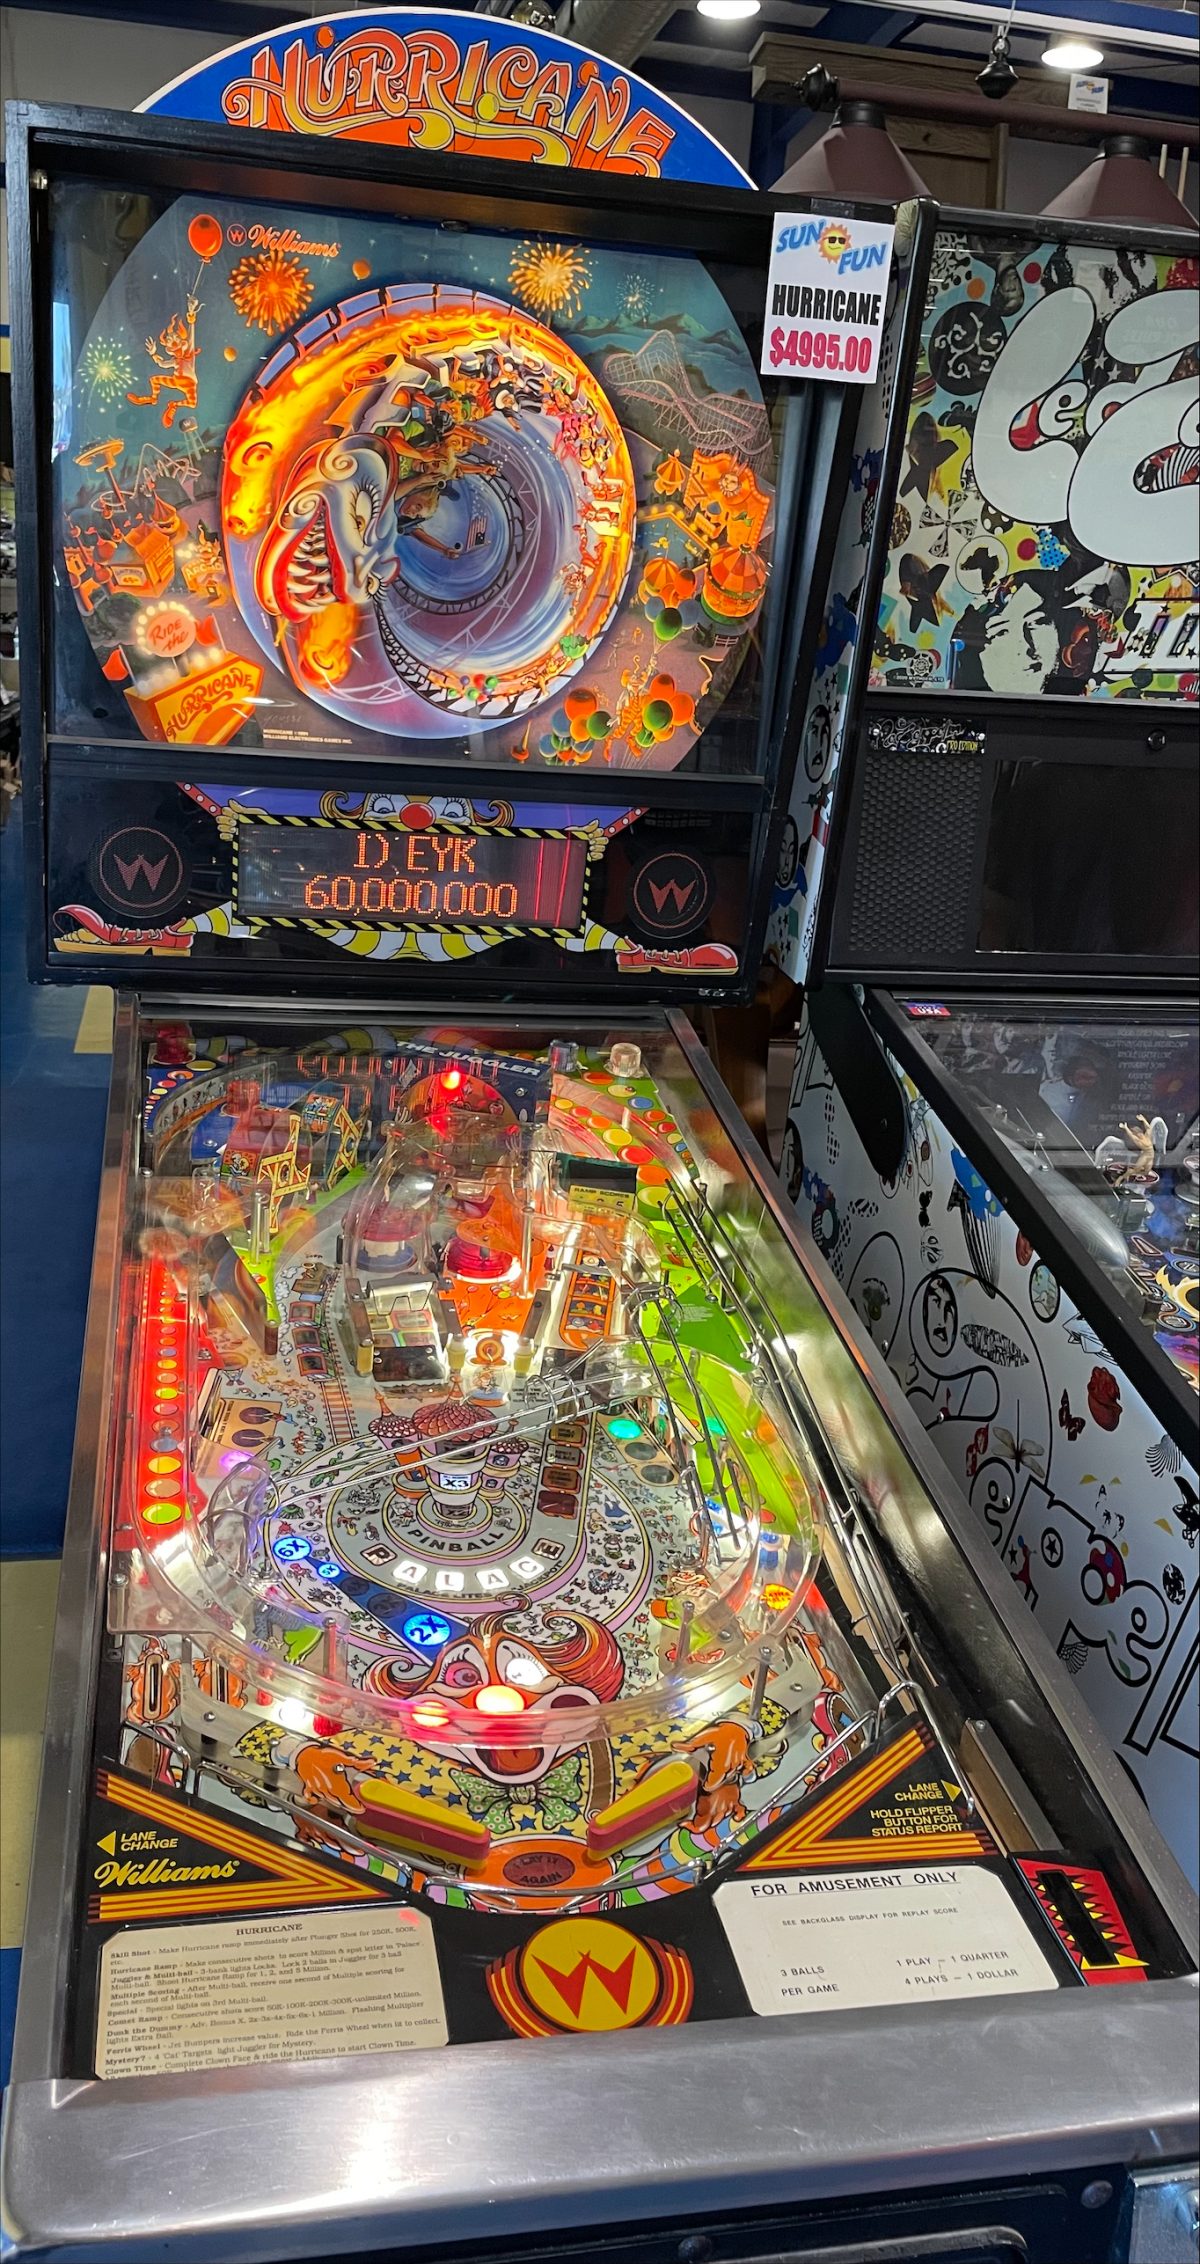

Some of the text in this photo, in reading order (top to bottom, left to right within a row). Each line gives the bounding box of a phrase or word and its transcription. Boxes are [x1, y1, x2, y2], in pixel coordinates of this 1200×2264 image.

[222, 28, 677, 178] HURRICANE
[247, 223, 340, 257] Williams
[776, 219, 827, 253] SUN
[837, 242, 889, 275] FUN
[772, 284, 881, 326] HURRICANE
[770, 326, 872, 374] $4995.00
[151, 618, 183, 643] RIDE
[162, 630, 190, 652] the
[166, 667, 256, 742] HURRICANE
[407, 835, 477, 873] EYK
[304, 874, 518, 920] 60,000,000
[397, 1041, 541, 1076] THE JUGGLER
[278, 1539, 307, 1557] 6X
[407, 1529, 504, 1552] PINBALL
[409, 1615, 447, 1642] 2X
[894, 1791, 944, 1801] CHANGE
[909, 1783, 940, 1792] LANE
[870, 1805, 953, 1819] HOLD FLIPPER
[884, 1814, 958, 1827] BUTTON FOR
[121, 1831, 157, 1843] LANE
[872, 1823, 962, 1837] STATUS REPORT
[120, 1838, 178, 1852] CHANGE
[94, 1858, 238, 1888] Williams
[750, 1872, 959, 1897] FOR AMUSEMENT ONLY
[800, 1915, 845, 1925] BACKGLASS
[849, 1913, 879, 1922] DISPLAY
[882, 1911, 898, 1919] FOR
[901, 1909, 929, 1918] REPLAY
[933, 1907, 959, 1915] SCORE
[236, 1923, 303, 1936] HURRICANE
[159, 1946, 178, 1954] Make
[181, 1943, 219, 1952] Hurricane
[290, 1934, 308, 1942] after
[310, 1932, 337, 1942] Plunger
[110, 1965, 150, 1974] Hurricane
[154, 1962, 177, 1972] Ramp
[208, 1956, 250, 1965] consecutive
[310, 1948, 335, 1956] Million
[111, 1975, 142, 1985] Juggler
[153, 1970, 192, 1979] Multi-ball
[338, 1954, 366, 1964] Juggler
[780, 1965, 826, 1977] 3 BALLS
[896, 1951, 1009, 1967] 1 PLAY 1 QUARTER
[110, 1990, 144, 2001] Multiple
[250, 1978, 276, 1986] receive
[294, 1974, 320, 1982] second
[332, 1970, 362, 1980] Multiple
[181, 1974, 220, 1983] Hurricane
[222, 1972, 244, 1981] Ramp
[905, 1968, 1019, 1986] 4 PLAYS 1 DOLLAR
[130, 1996, 158, 2004] second
[781, 1983, 840, 1997] PER GAME
[107, 2008, 137, 2018] Special
[146, 2004, 173, 2014] Special
[107, 2028, 129, 2036] Dunk
[150, 2023, 182, 2034] Dummy
[352, 2005, 384, 2015] Flashing
[386, 2001, 423, 2012] Multiplier
[108, 2017, 135, 2025] Comet
[138, 2014, 162, 2024] Ramp
[171, 2009, 218, 2019] Consecutive
[221, 2007, 242, 2015] shots
[106, 2046, 131, 2054] Ferris
[134, 2043, 160, 2052] Wheel
[184, 2038, 219, 2048] Bumpers
[222, 2034, 254, 2044] increase
[286, 2030, 302, 2038] Ride
[320, 2026, 343, 2035] Ferris
[346, 2024, 369, 2032] Wheel
[371, 2022, 392, 2030] when
[104, 2066, 130, 2075] Clown
[134, 2064, 155, 2072] Time
[164, 2060, 202, 2071] Complete
[205, 2057, 231, 2065] Clown
[233, 2055, 251, 2063] Face
[295, 2047, 335, 2057] Hurricane
[348, 2044, 366, 2052] start
[368, 2042, 392, 2050] Clown
[395, 2040, 415, 2048] Time.
[105, 2055, 145, 2066] Mystery?
[182, 2049, 212, 2059] Targets
[217, 2047, 234, 2056] light
[236, 2044, 266, 2054] Juggler
[268, 2042, 279, 2050] for
[282, 2039, 315, 2050] Mystery.
